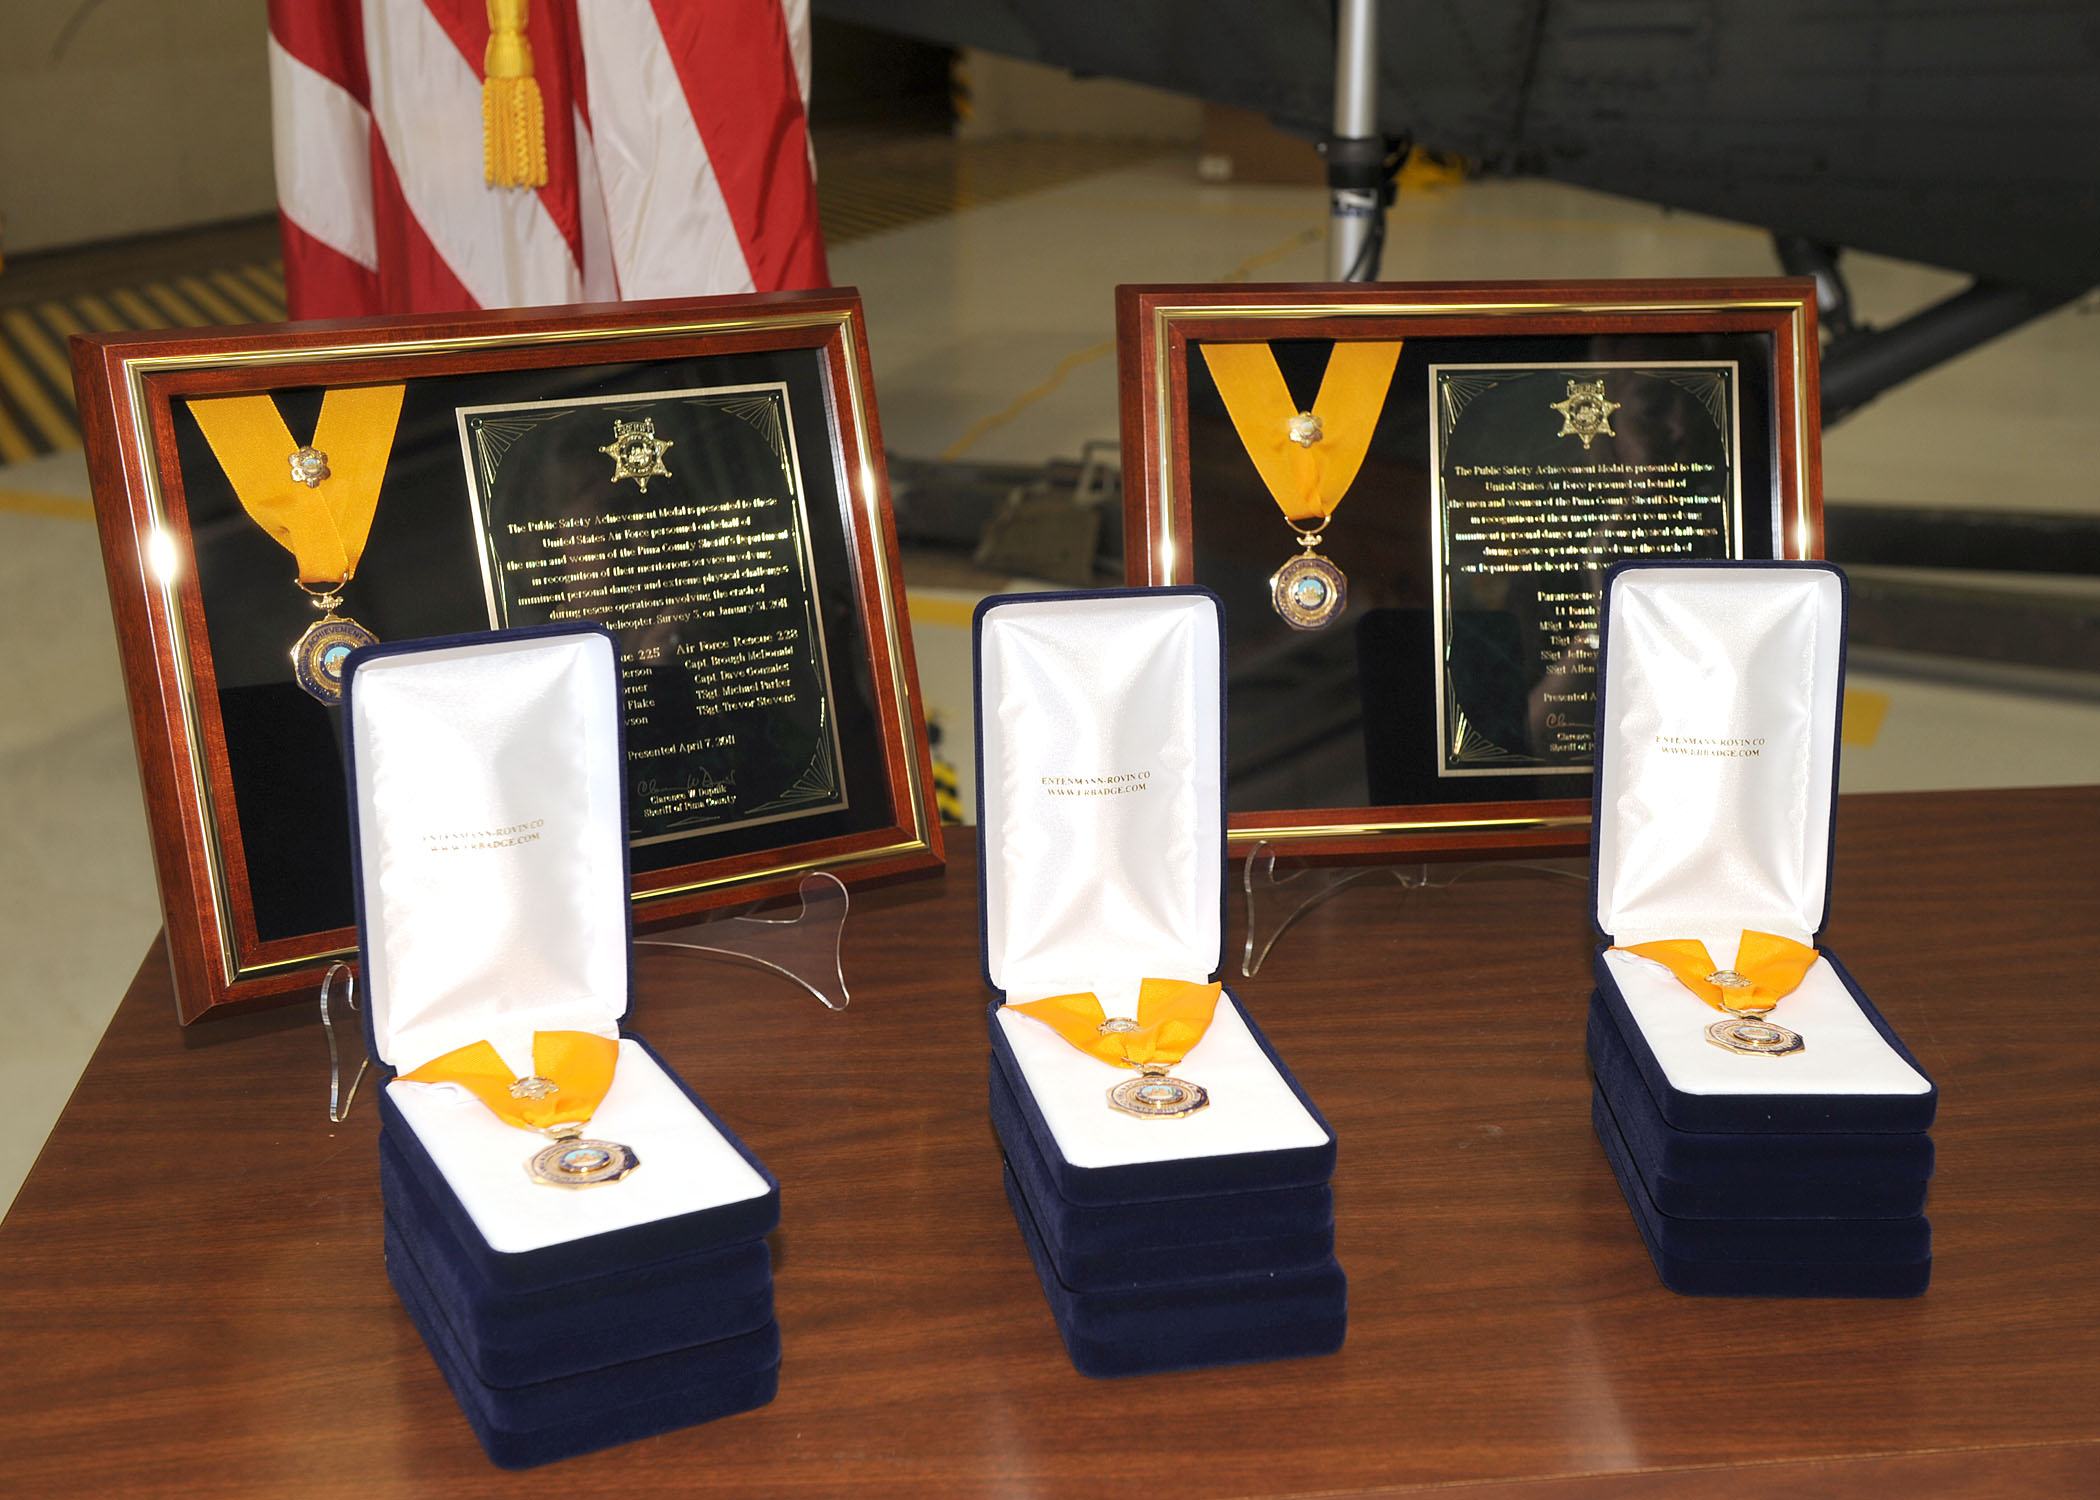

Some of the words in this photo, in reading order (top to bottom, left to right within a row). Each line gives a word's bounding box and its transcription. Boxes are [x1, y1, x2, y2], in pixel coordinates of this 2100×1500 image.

[1454, 466, 1472, 476] The
[1474, 466, 1501, 476] Public
[1502, 466, 1533, 476] Safety
[1536, 464, 1596, 475] Achievement
[1598, 464, 1624, 473] Medal
[1626, 464, 1633, 473] is
[1634, 462, 1678, 474] presented
[1680, 464, 1689, 472] to
[1691, 462, 1715, 472] these
[1485, 482, 1516, 492] United
[1516, 482, 1544, 491] States
[1547, 482, 1560, 491] Air
[1562, 480, 1586, 490] Force
[1588, 480, 1632, 492] personnel
[1634, 481, 1646, 489] on
[1646, 478, 1675, 489] behalf
[1676, 478, 1687, 488] of
[507, 523, 526, 534] The
[528, 520, 557, 532] Public
[559, 516, 591, 529] Safety
[594, 510, 657, 524] Achievement
[659, 506, 686, 518] Medal
[688, 507, 695, 515] is
[697, 499, 741, 516] presented
[742, 500, 751, 509] to
[753, 497, 778, 508] these
[542, 535, 575, 548] United
[576, 534, 605, 545] States
[608, 532, 622, 541] Air
[624, 528, 649, 539] Force
[651, 522, 697, 539] personnel
[698, 523, 710, 531] on
[711, 517, 740, 530] behalf
[741, 516, 751, 526] of
[506, 560, 523, 571] the
[526, 559, 547, 569] men
[549, 554, 567, 566] and
[569, 552, 605, 563] women
[607, 548, 617, 559] of
[620, 547, 636, 558] the
[638, 545, 660, 556] Pima
[662, 540, 696, 552] County
[736, 529, 788, 545] Department
[532, 577, 542, 586] in
[544, 569, 599, 585] recognition
[600, 567, 610, 577] of
[613, 565, 635, 577] their
[638, 558, 691, 573] meritorious
[692, 556, 725, 567] service
[726, 550, 772, 563] involving
[518, 591, 566, 606] imminent
[567, 586, 608, 602] personal
[610, 584, 641, 595] danger
[644, 579, 661, 590] and
[662, 577, 701, 588] extreme
[702, 569, 740, 586] physical
[742, 565, 789, 579] challenges
[550, 610, 581, 621] during
[582, 604, 614, 616] rescue
[614, 598, 664, 614] operations
[666, 593, 712, 605] involving
[712, 588, 728, 600] the
[730, 585, 754, 597] crash
[755, 582, 766, 594] of
[1537, 591, 1596, 602] Pararescue
[656, 610, 691, 625] Survey
[702, 610, 715, 618] on
[719, 604, 754, 616] January
[1555, 606, 1566, 616] Lt
[1568, 604, 1596, 616] Isaiah
[1539, 620, 1563, 632] MSgt
[1568, 620, 1598, 631] Joshua
[676, 644, 696, 656] Air
[700, 641, 729, 653] Force
[733, 636, 773, 648] Rescue
[776, 629, 799, 642] 228
[1550, 635, 1571, 647] TSgt
[638, 647, 661, 660] 225
[684, 658, 707, 671] Capt
[711, 653, 746, 667] Brough
[748, 646, 794, 661] McDonald
[1540, 650, 1561, 661] SSgt
[1568, 649, 1598, 660] Jeffrey
[694, 672, 716, 685] Capt
[721, 670, 746, 680] Dave
[746, 662, 789, 677] Gonzales
[1546, 664, 1567, 676] SSgt
[1570, 664, 1595, 674] Allen
[696, 688, 718, 701] TSgt
[723, 682, 758, 696] Michael
[760, 678, 791, 691] Parker
[1544, 692, 1588, 702] Presented
[628, 698, 656, 710] Flake
[696, 704, 719, 717] TSgt
[722, 700, 755, 713] Trevor
[756, 693, 796, 708] Stevens
[628, 744, 676, 761] Presented
[679, 739, 702, 754] April
[716, 734, 736, 746] 2011
[1752, 738, 1766, 746] CO
[1138, 770, 1151, 780] CO
[650, 792, 686, 805] Clarence
[699, 784, 727, 797] Dupnik
[1047, 784, 1147, 797] WWWERBADGE.COM
[644, 806, 672, 818] Sheriff
[674, 802, 683, 812] of
[684, 800, 705, 811] Pima
[706, 794, 737, 807] County
[530, 818, 545, 829] CO
